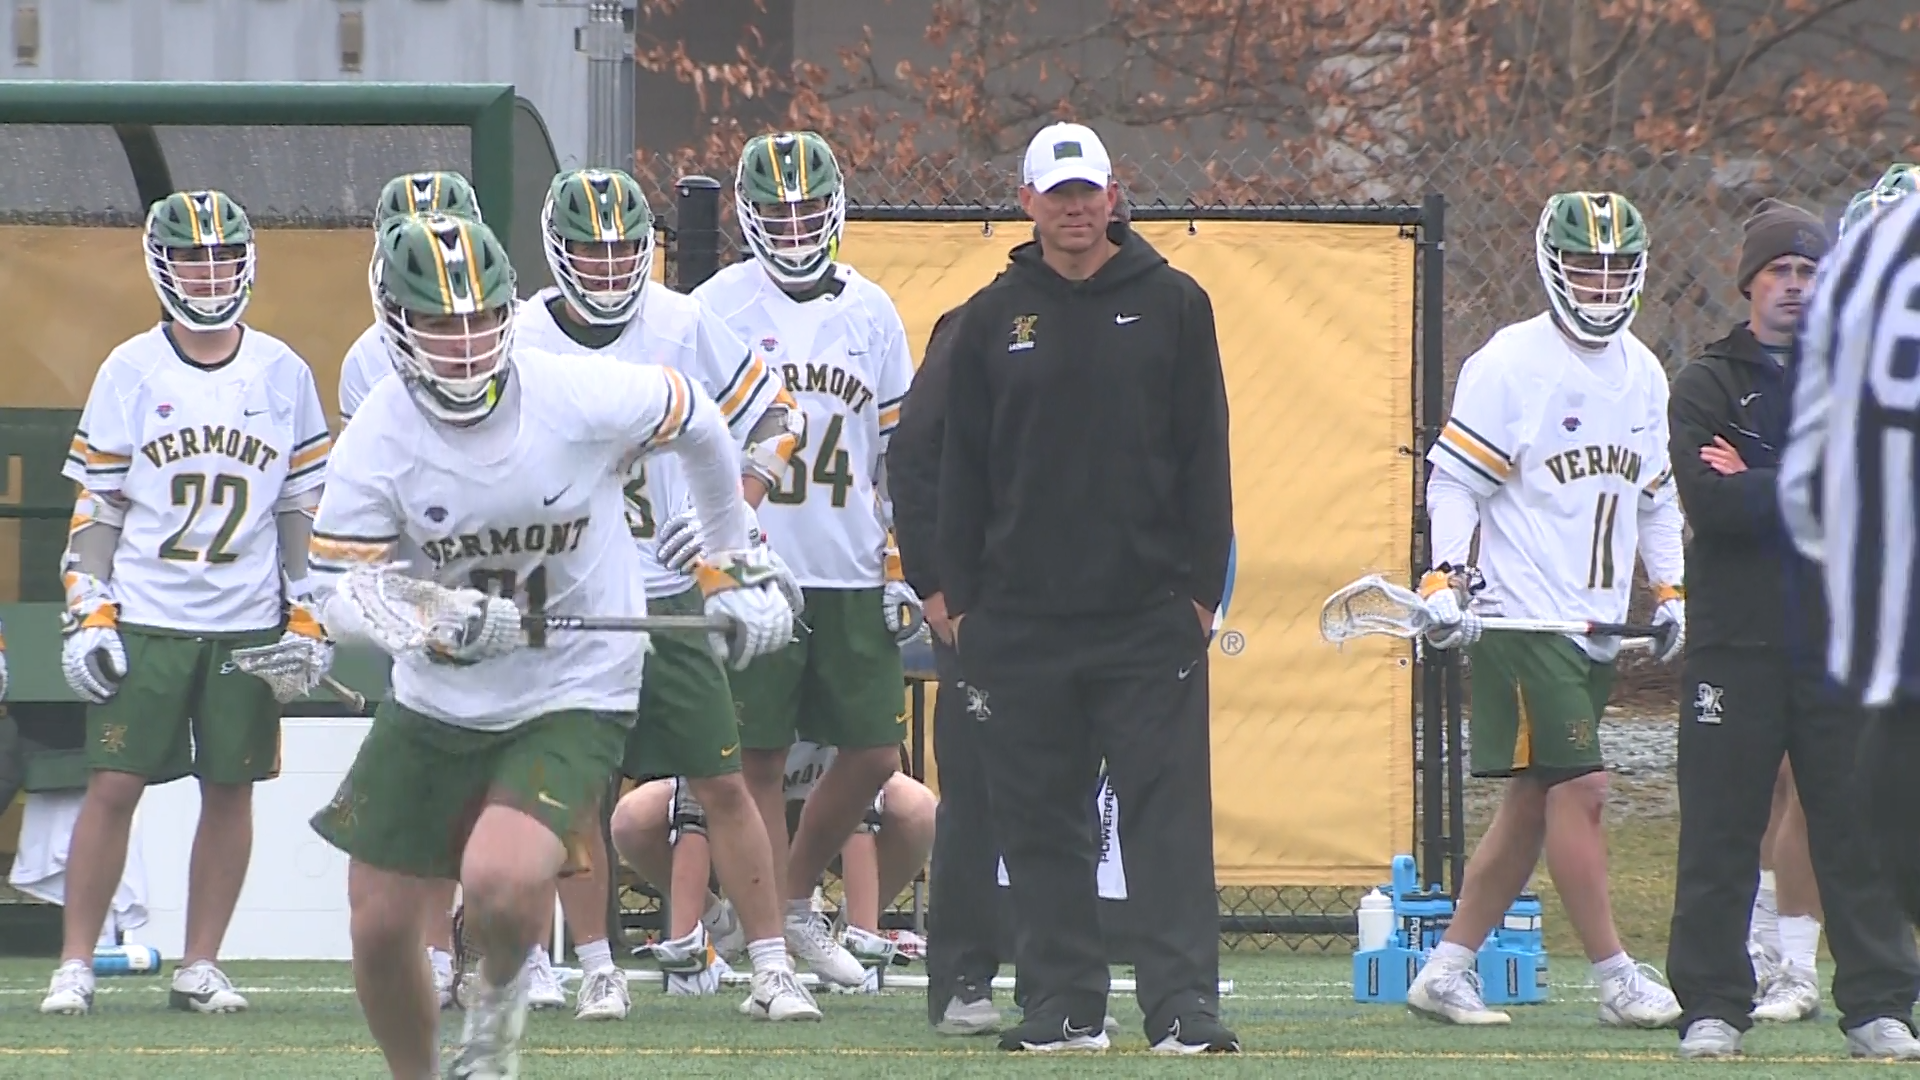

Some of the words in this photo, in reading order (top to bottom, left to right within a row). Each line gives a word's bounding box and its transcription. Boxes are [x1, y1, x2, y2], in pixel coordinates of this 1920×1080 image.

[141, 425, 279, 472] VERMONT
[158, 473, 249, 564] 22
[421, 517, 590, 569] VERMONT
[1588, 492, 1619, 589] 11
[1101, 780, 1115, 863] POWERAD
